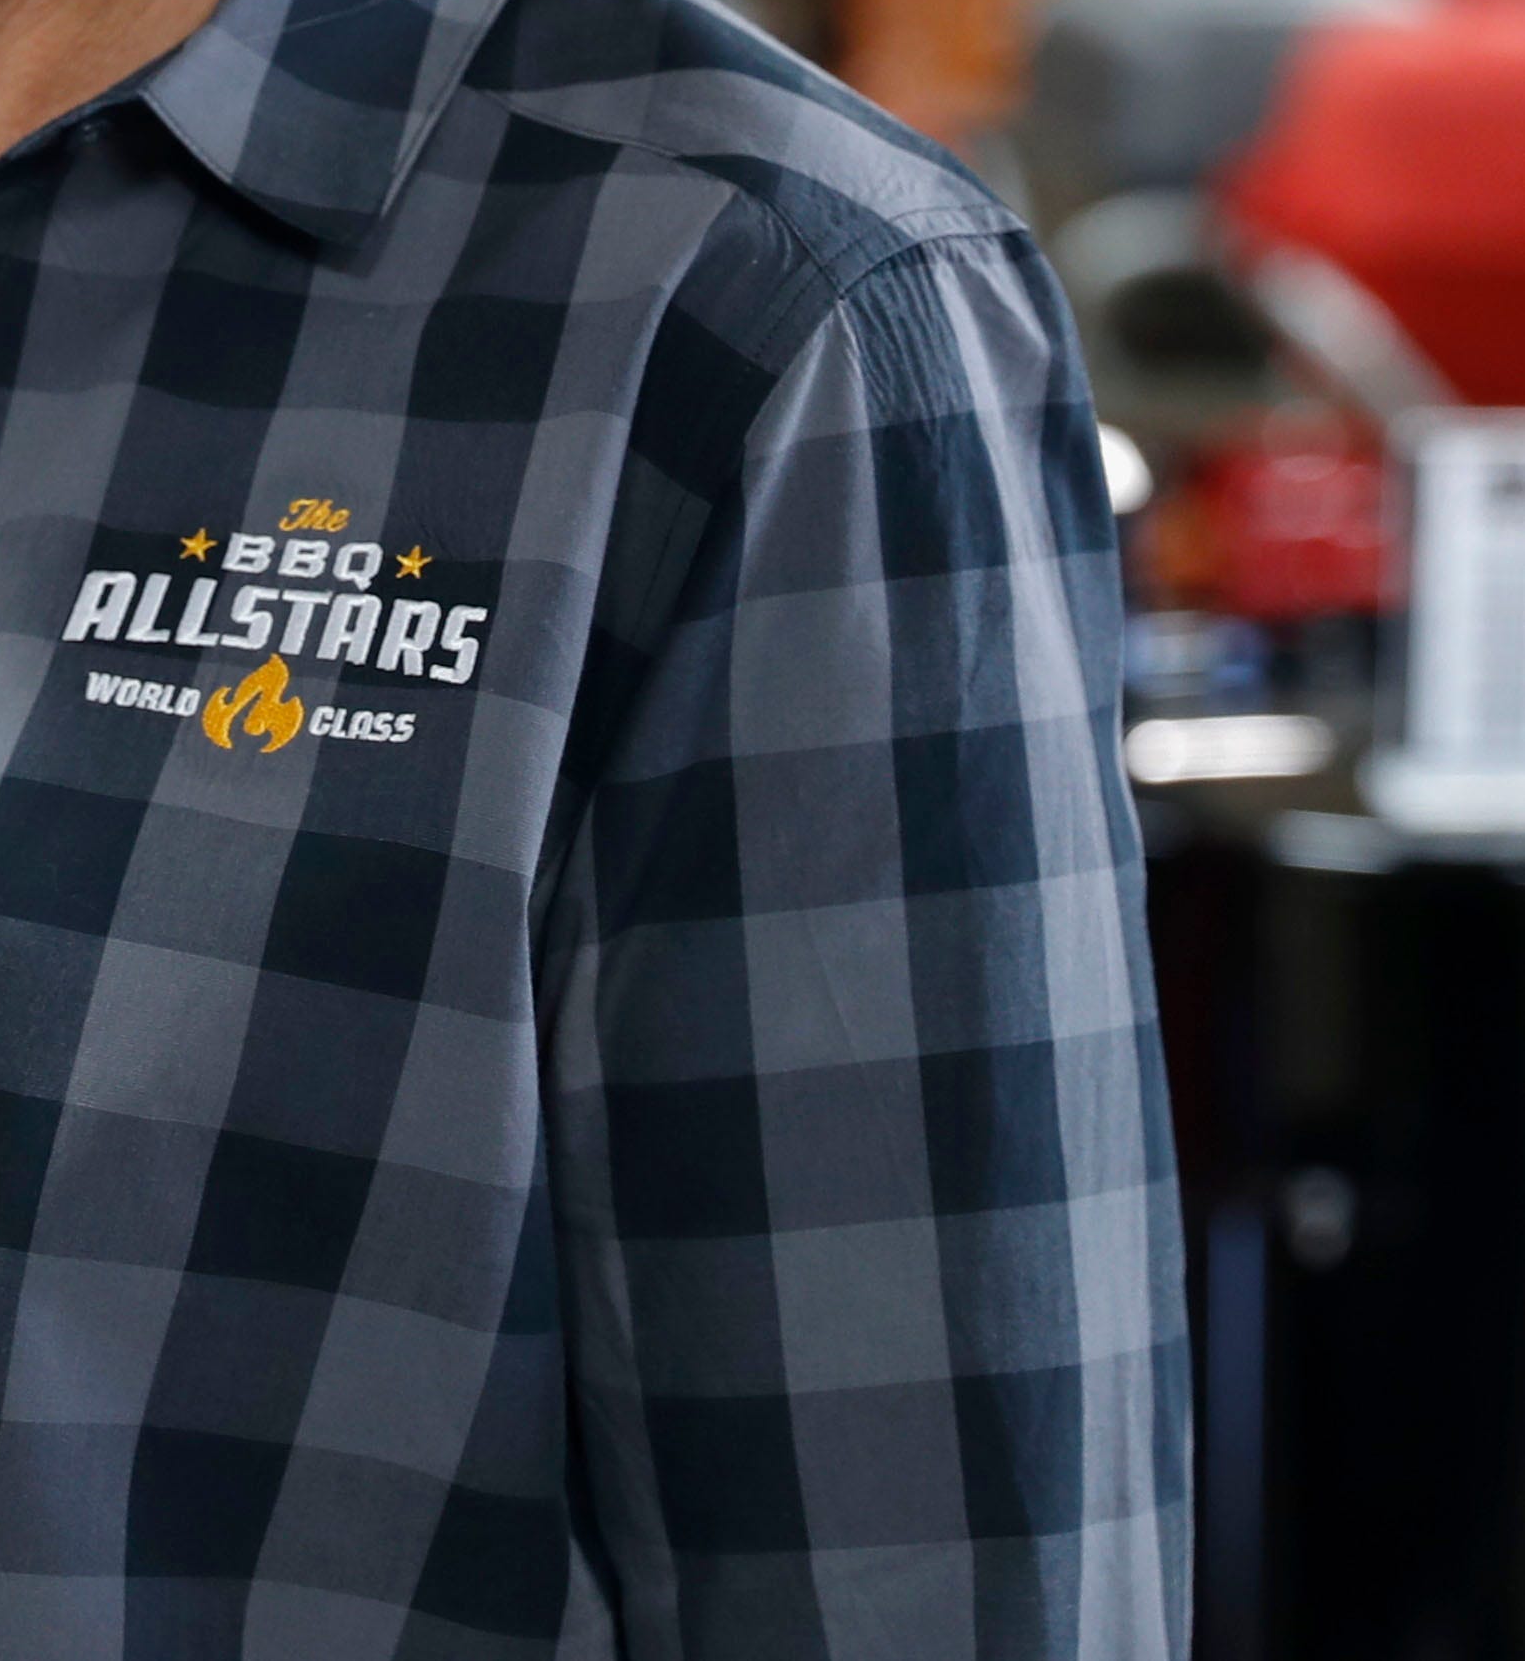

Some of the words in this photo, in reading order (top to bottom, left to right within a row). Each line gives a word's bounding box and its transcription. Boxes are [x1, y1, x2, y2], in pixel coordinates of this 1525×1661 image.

[278, 497, 351, 533] The
[221, 531, 384, 590] BBQ
[61, 569, 490, 685] ALLSTARS
[84, 670, 202, 718] WORLD
[307, 705, 417, 743] CLASS
